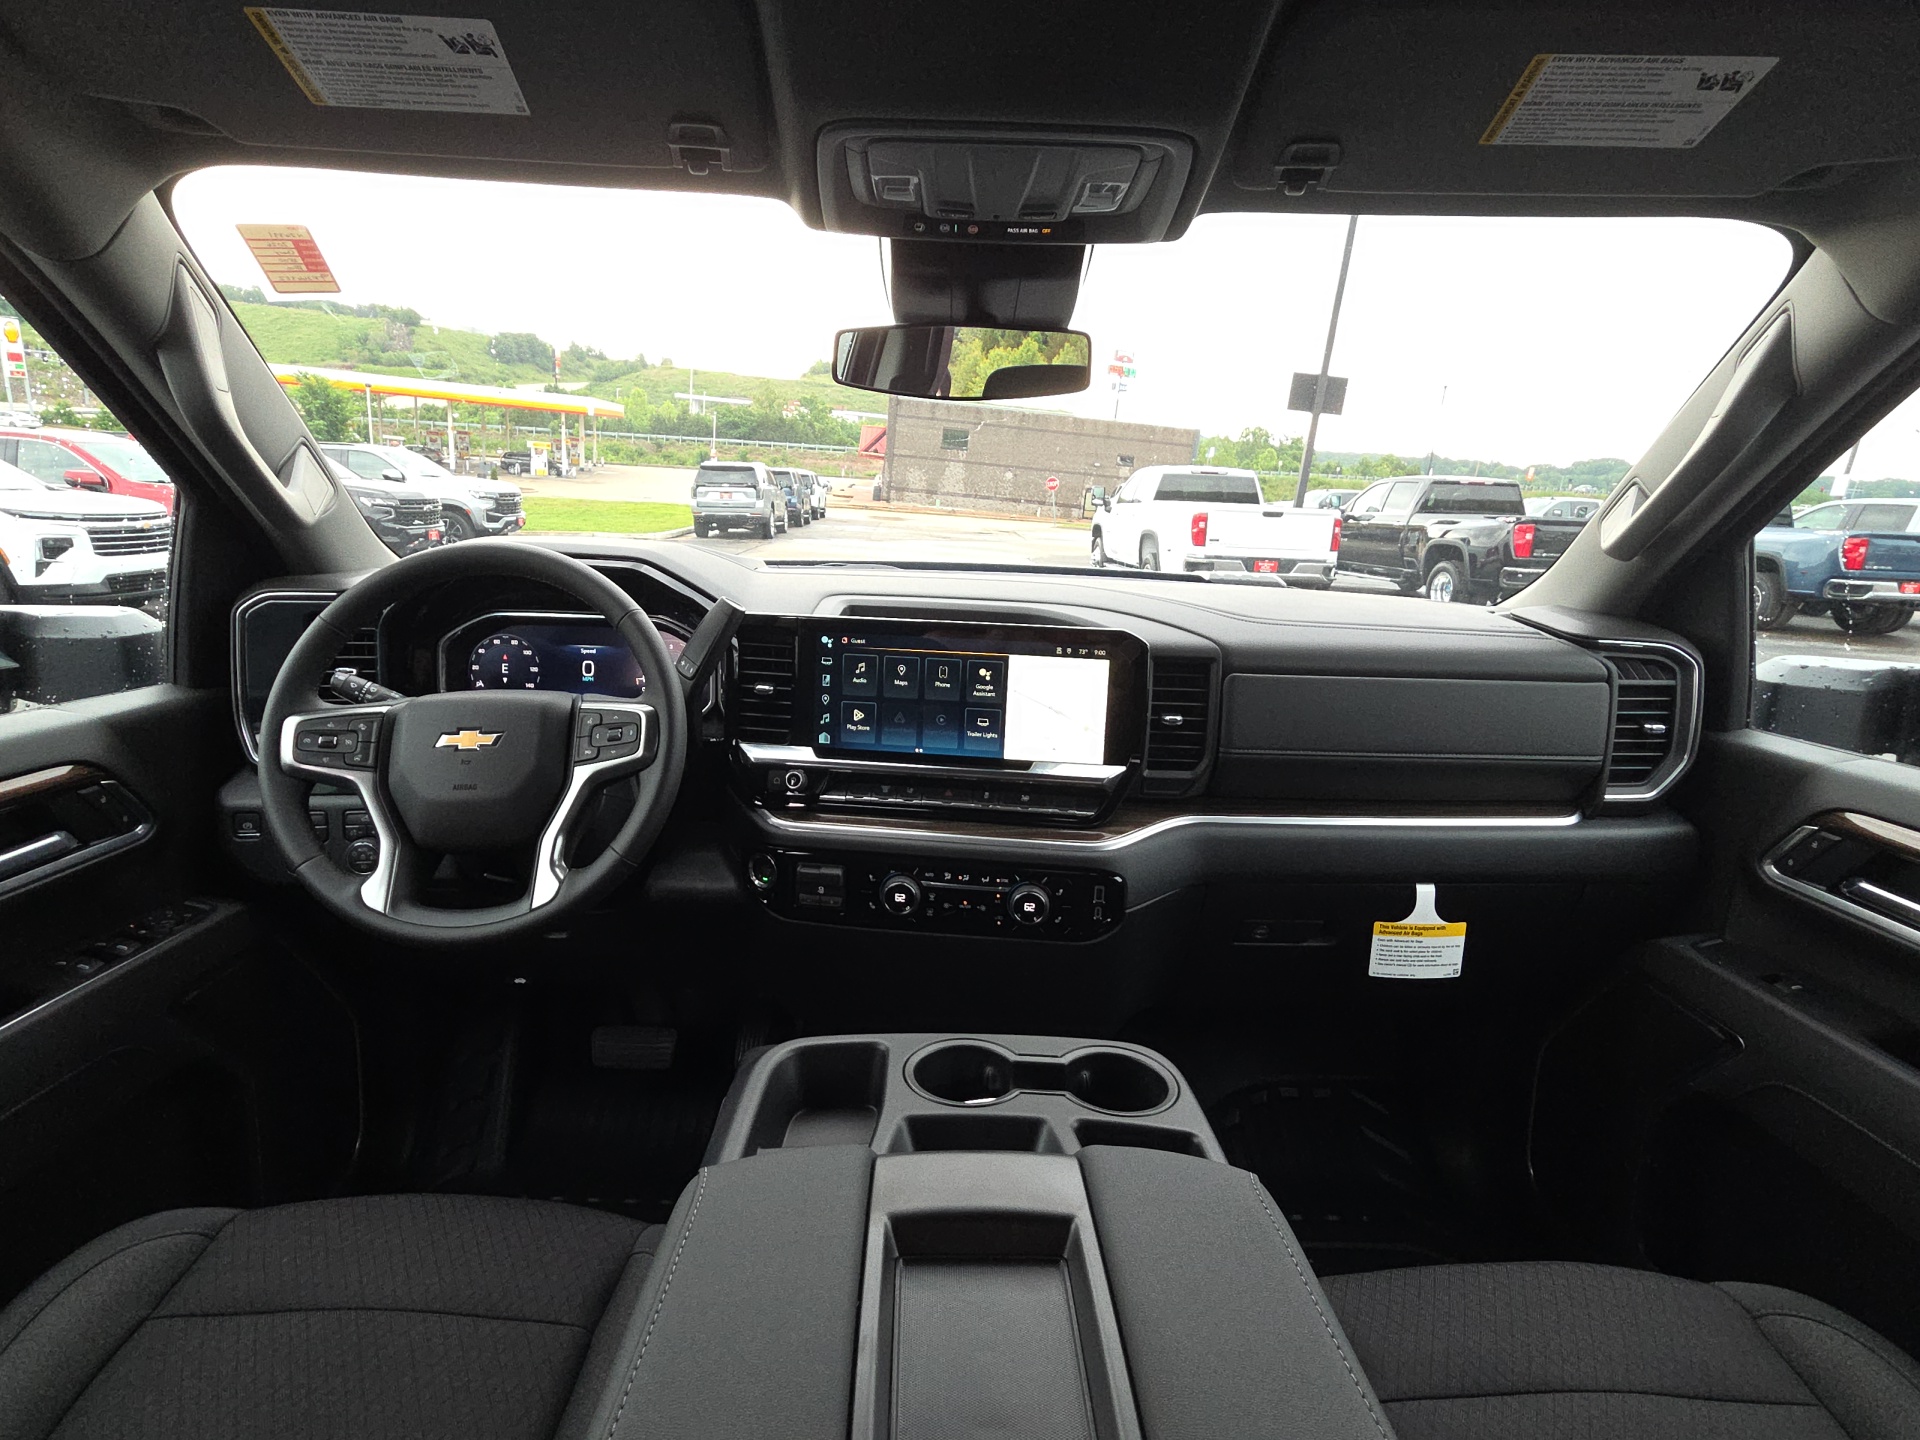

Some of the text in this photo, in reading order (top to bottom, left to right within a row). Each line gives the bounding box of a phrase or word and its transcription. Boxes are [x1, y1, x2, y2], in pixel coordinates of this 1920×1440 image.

[291, 10, 314, 19] WITH
[315, 11, 362, 22] ADVANCED
[363, 13, 378, 22] AIR
[379, 15, 403, 24] BAGS
[1597, 56, 1643, 64] ADVANCED
[1661, 57, 1685, 65] BAGS
[501, 663, 509, 674] E
[582, 660, 595, 677] 0
[894, 679, 908, 687] Maps
[975, 683, 994, 691] Google
[846, 723, 870, 732] Play Store
[967, 730, 983, 739] Trailer
[983, 731, 998, 741] Lights
[452, 783, 478, 791] AIRBAG
[894, 893, 906, 903] 62
[1023, 902, 1036, 912] 62
